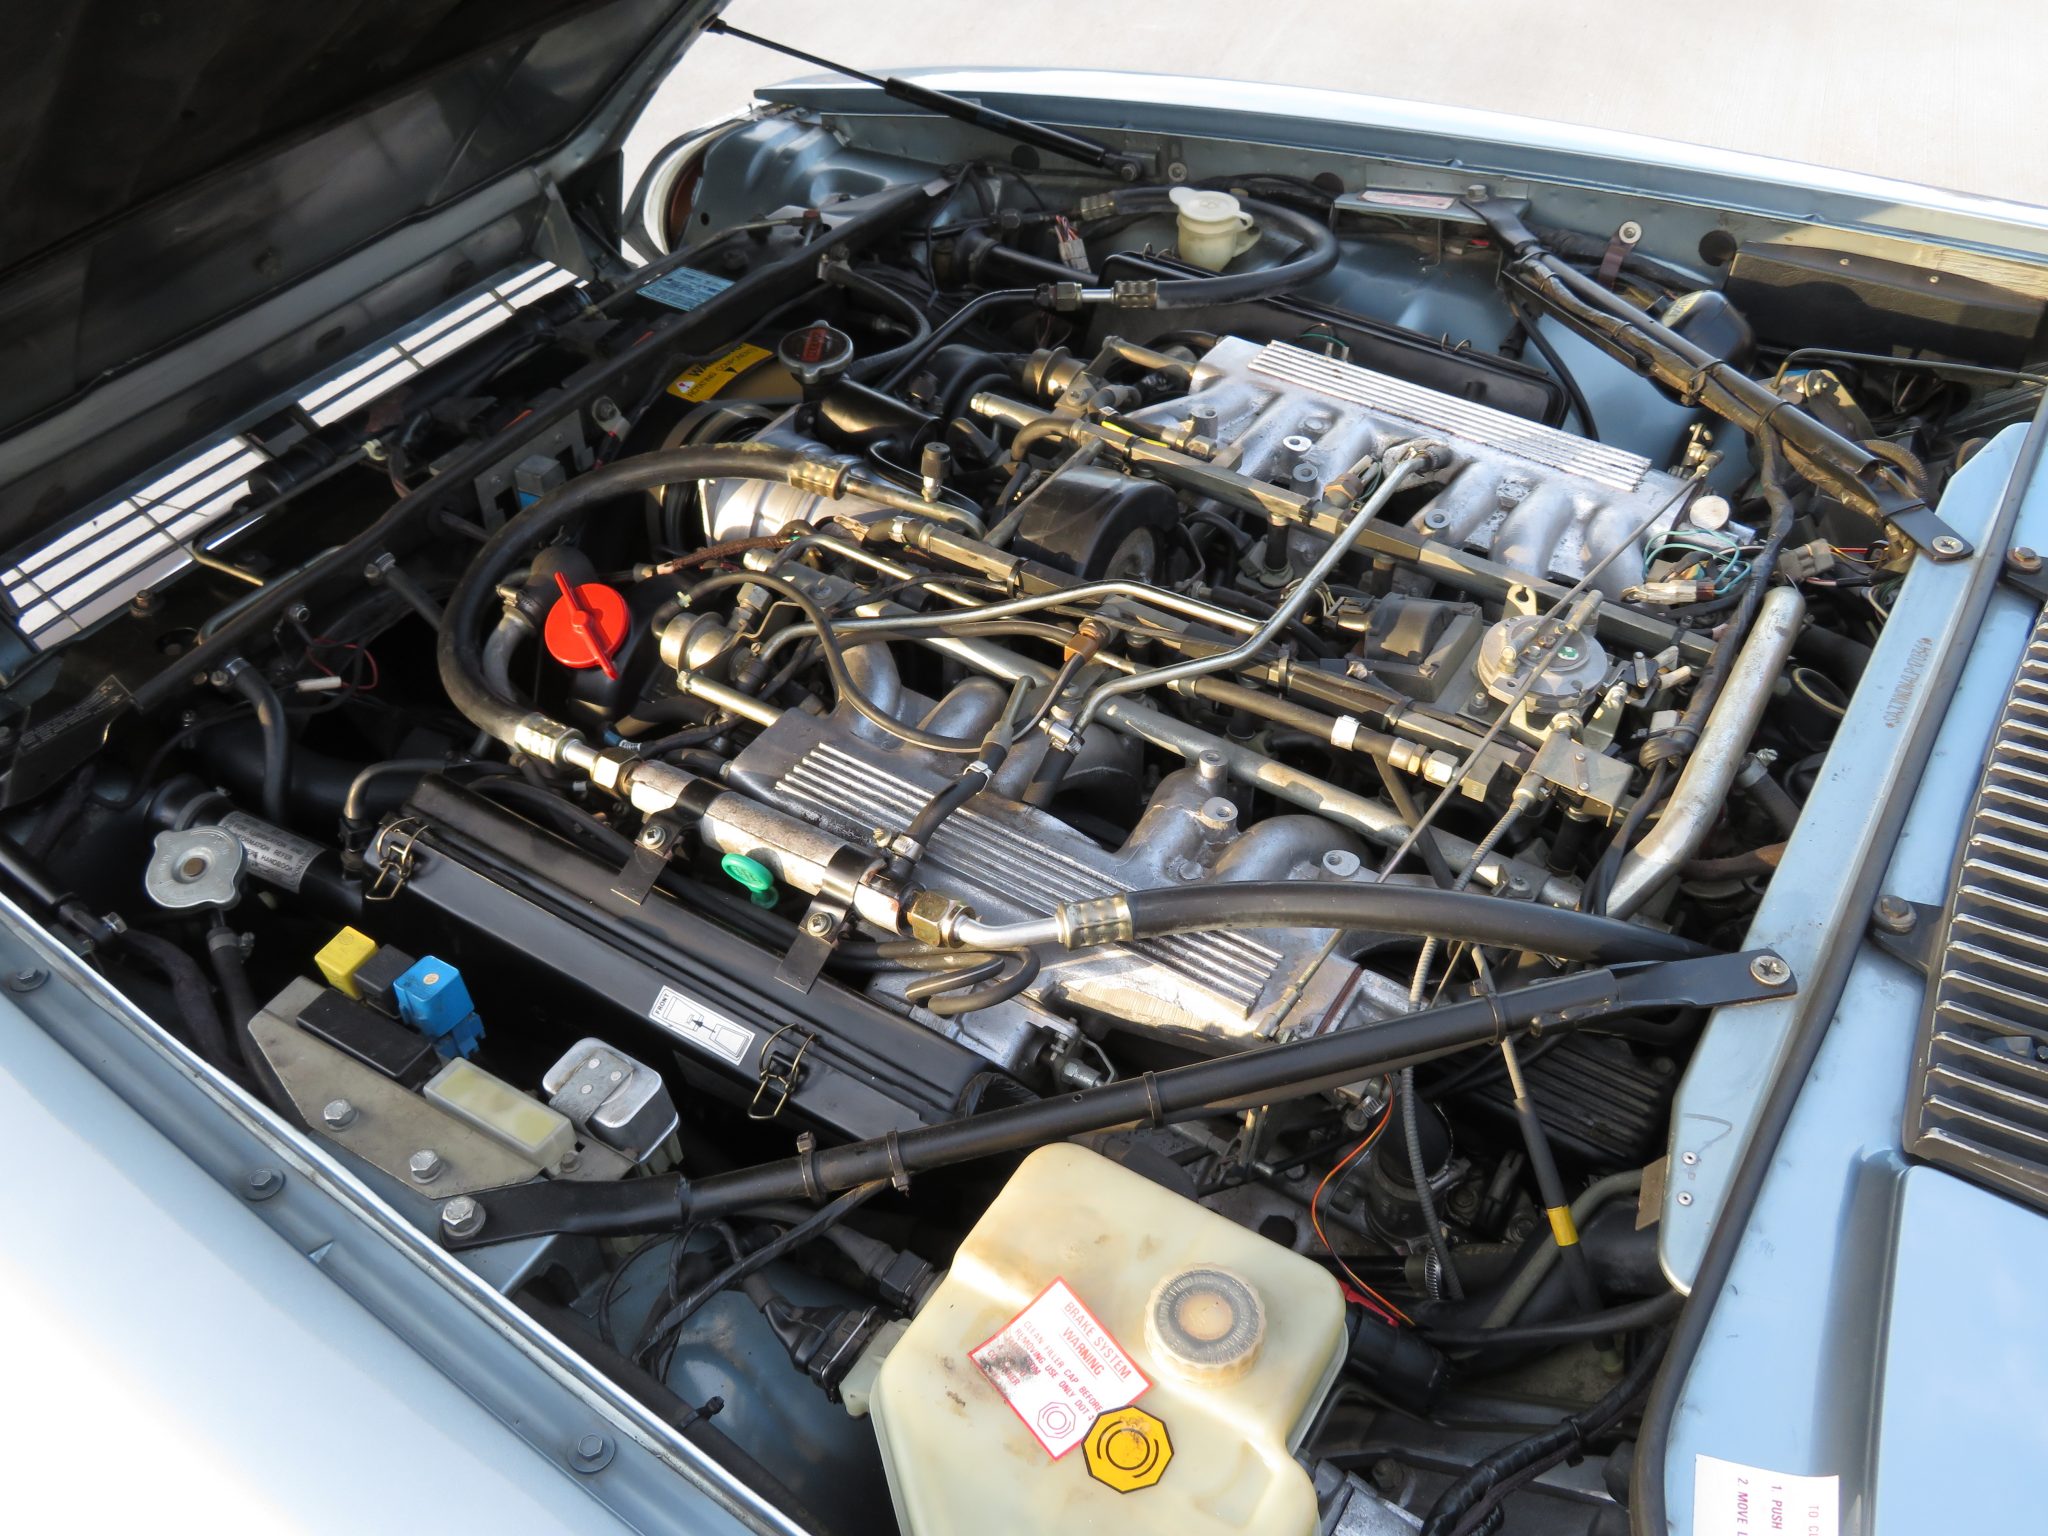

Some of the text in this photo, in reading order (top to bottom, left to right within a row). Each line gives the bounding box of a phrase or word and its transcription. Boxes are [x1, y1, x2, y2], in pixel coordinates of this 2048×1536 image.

[655, 993, 670, 1015] FRONT
[1062, 1327, 1104, 1375] WARNING
[1064, 1302, 1131, 1379] BRAKE SYSTEM
[1015, 1329, 1046, 1363] REMOVING
[1045, 1365, 1058, 1378] USE
[1059, 1381, 1075, 1398] ONLY
[1075, 1400, 1088, 1414] DOT
[1024, 1321, 1103, 1413] CLEAN FILLER CAP BEFORE
[1736, 1491, 1749, 1525] MOVE
[1771, 1499, 1783, 1530] PUSH
[1808, 1506, 1820, 1518] TO
